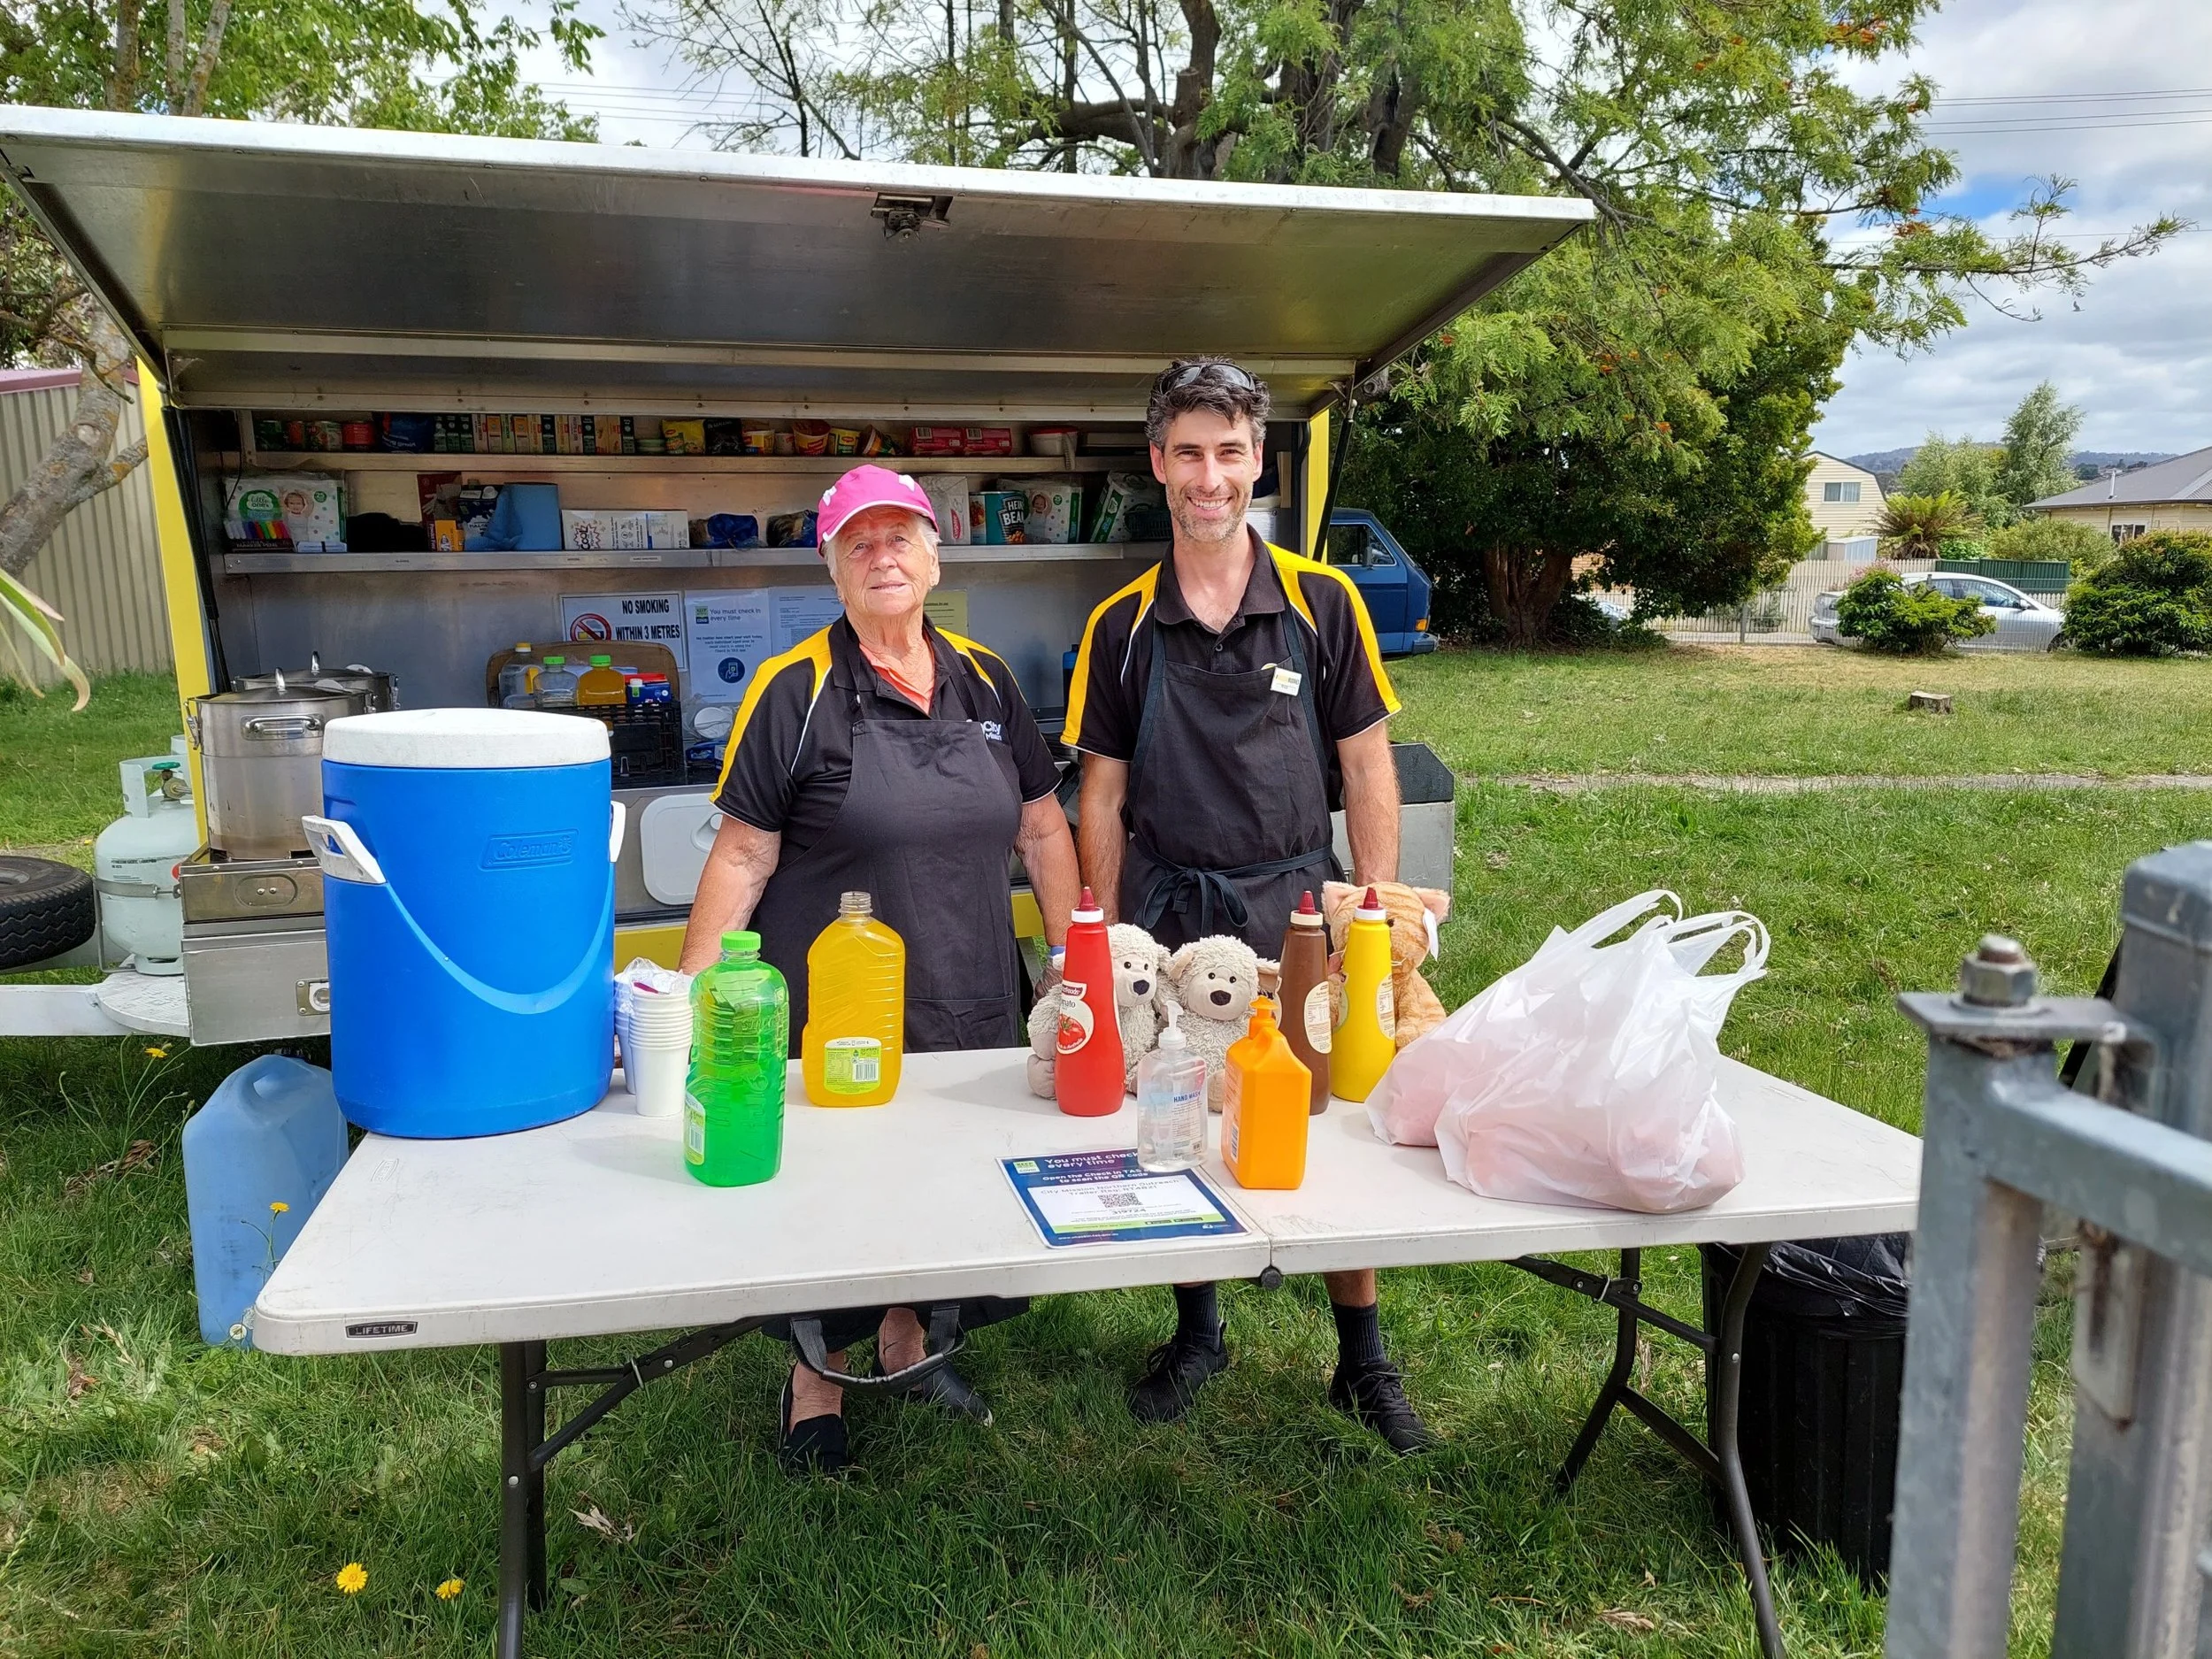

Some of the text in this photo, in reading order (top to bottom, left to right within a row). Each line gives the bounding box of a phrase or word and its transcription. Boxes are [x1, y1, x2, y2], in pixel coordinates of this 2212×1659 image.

[1007, 500, 1025, 511] HEIN
[622, 599, 670, 614] NO SMOKING
[615, 625, 680, 641] WITHIN 3 METRES
[495, 840, 558, 860] Coleman
[1173, 1094, 1187, 1102] HAND
[1072, 1154, 1102, 1163] must
[356, 1324, 408, 1335] LIFETIME
